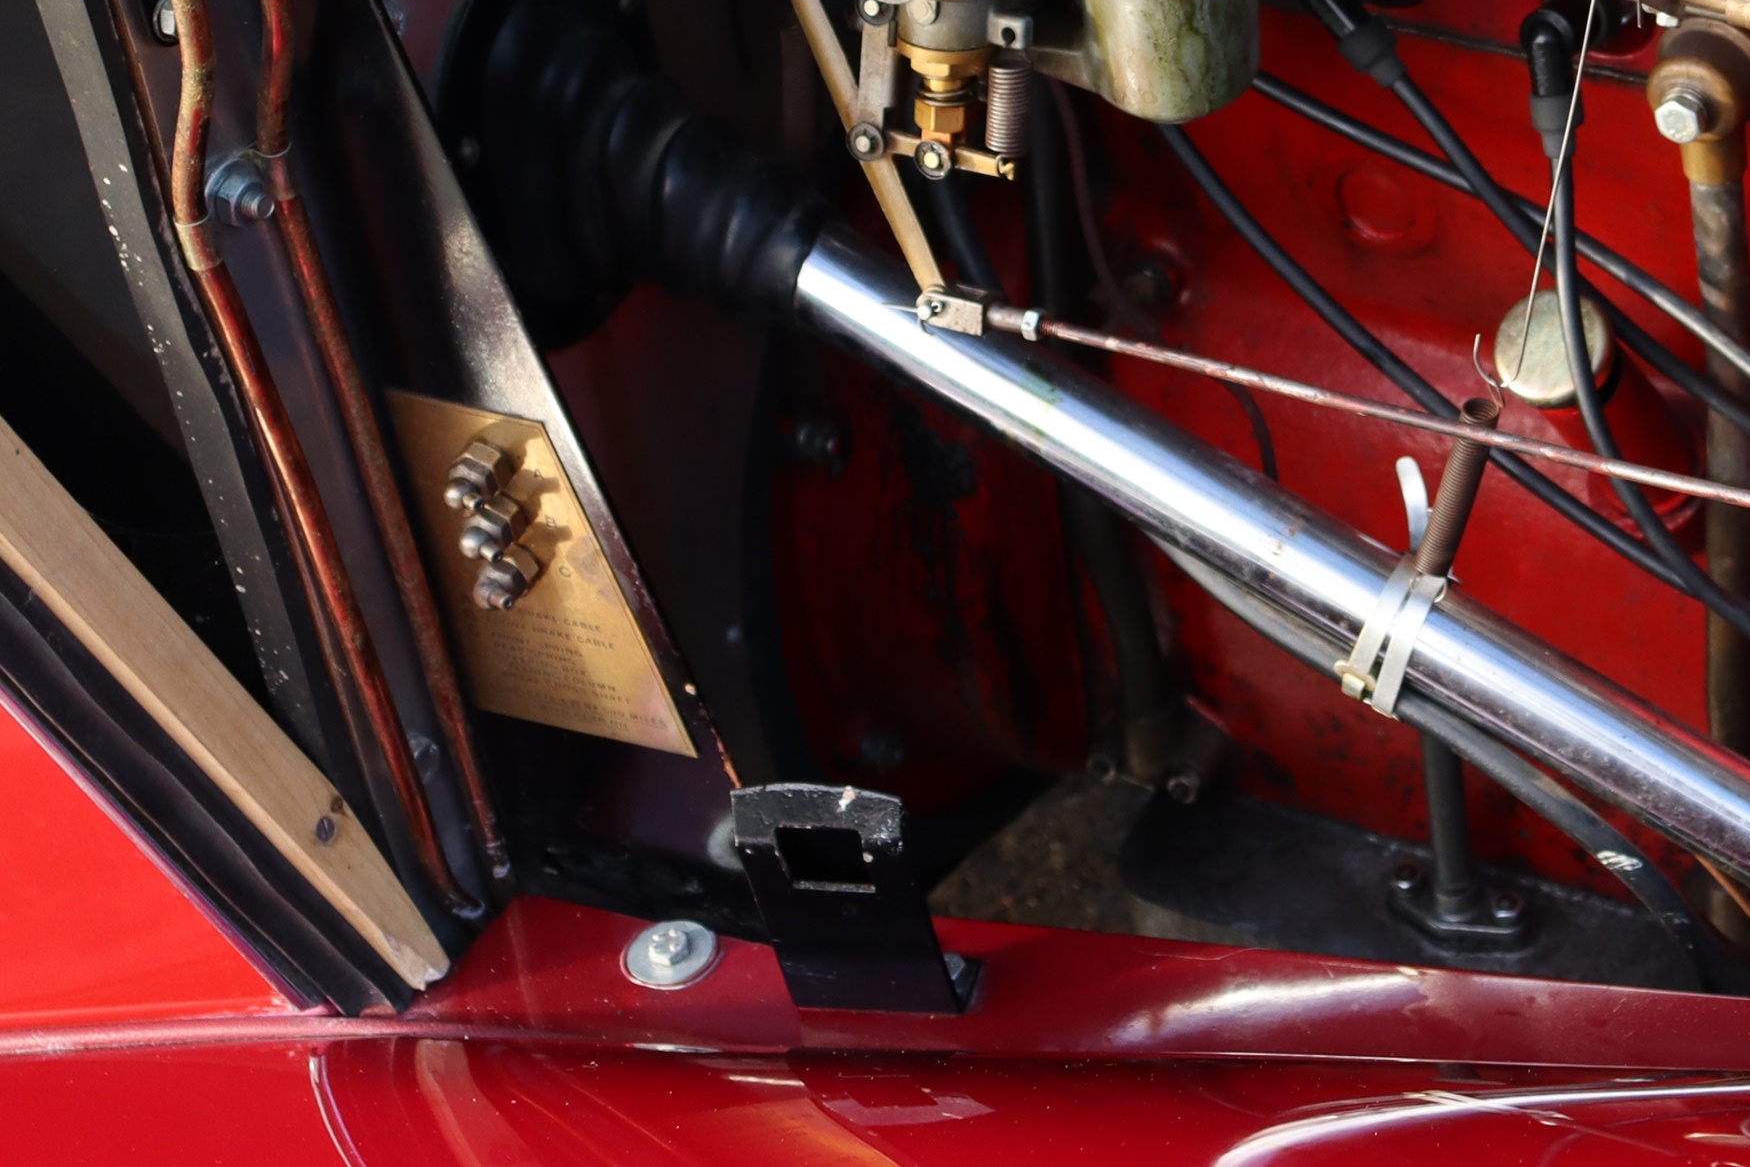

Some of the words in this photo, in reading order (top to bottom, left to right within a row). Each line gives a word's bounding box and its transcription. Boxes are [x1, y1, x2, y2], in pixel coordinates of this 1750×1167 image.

[533, 469, 545, 481] A
[545, 516, 558, 529] B
[558, 565, 572, 578] C
[561, 617, 603, 633] CABLE
[574, 634, 616, 651] CABLE
